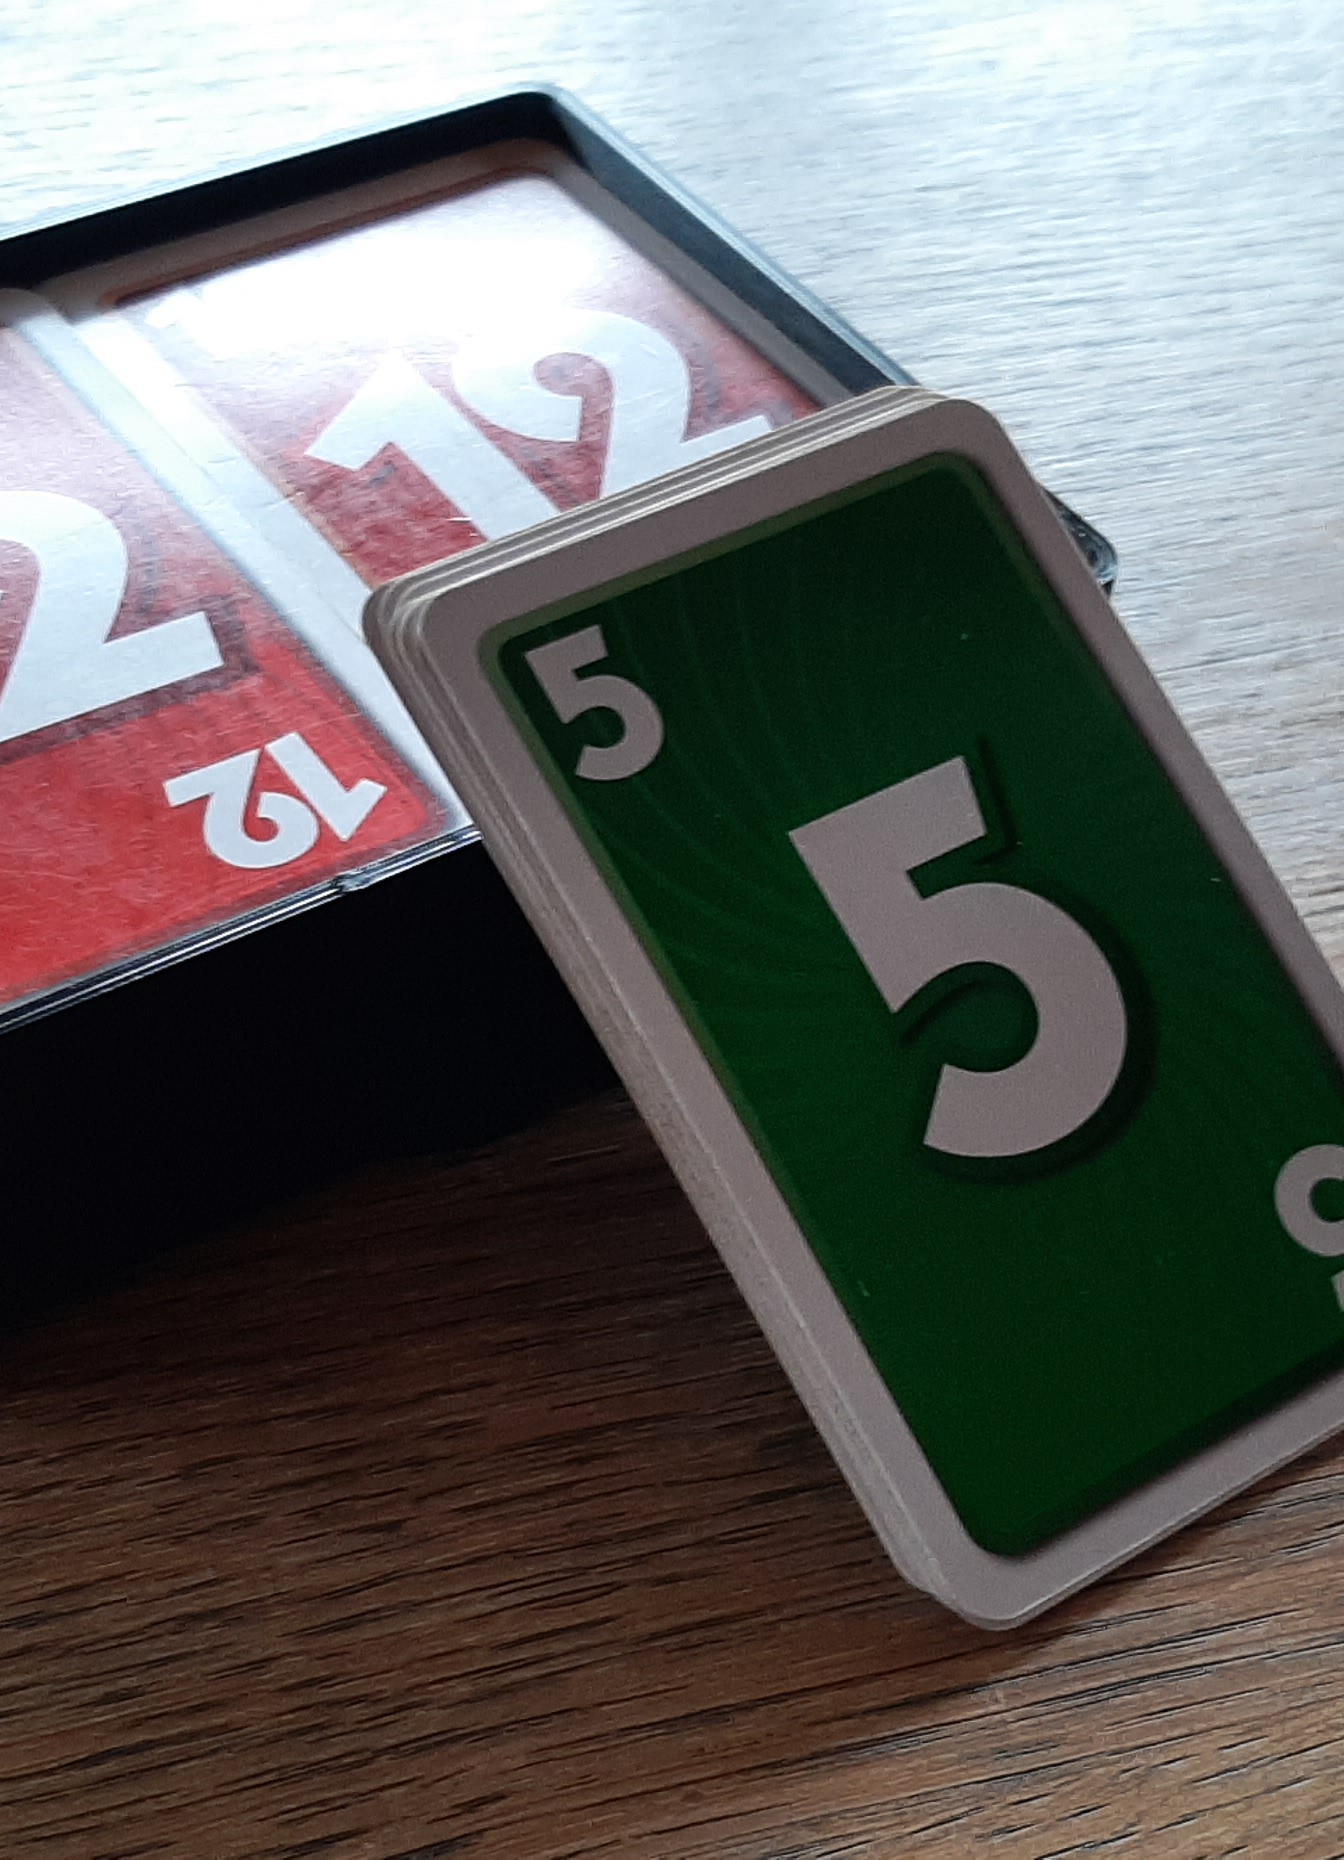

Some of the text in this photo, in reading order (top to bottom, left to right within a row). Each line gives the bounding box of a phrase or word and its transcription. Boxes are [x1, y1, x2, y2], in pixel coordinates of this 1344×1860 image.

[306, 308, 774, 540] 12
[526, 625, 663, 780] 5
[164, 733, 386, 868] 12
[790, 757, 1126, 1157] 5
